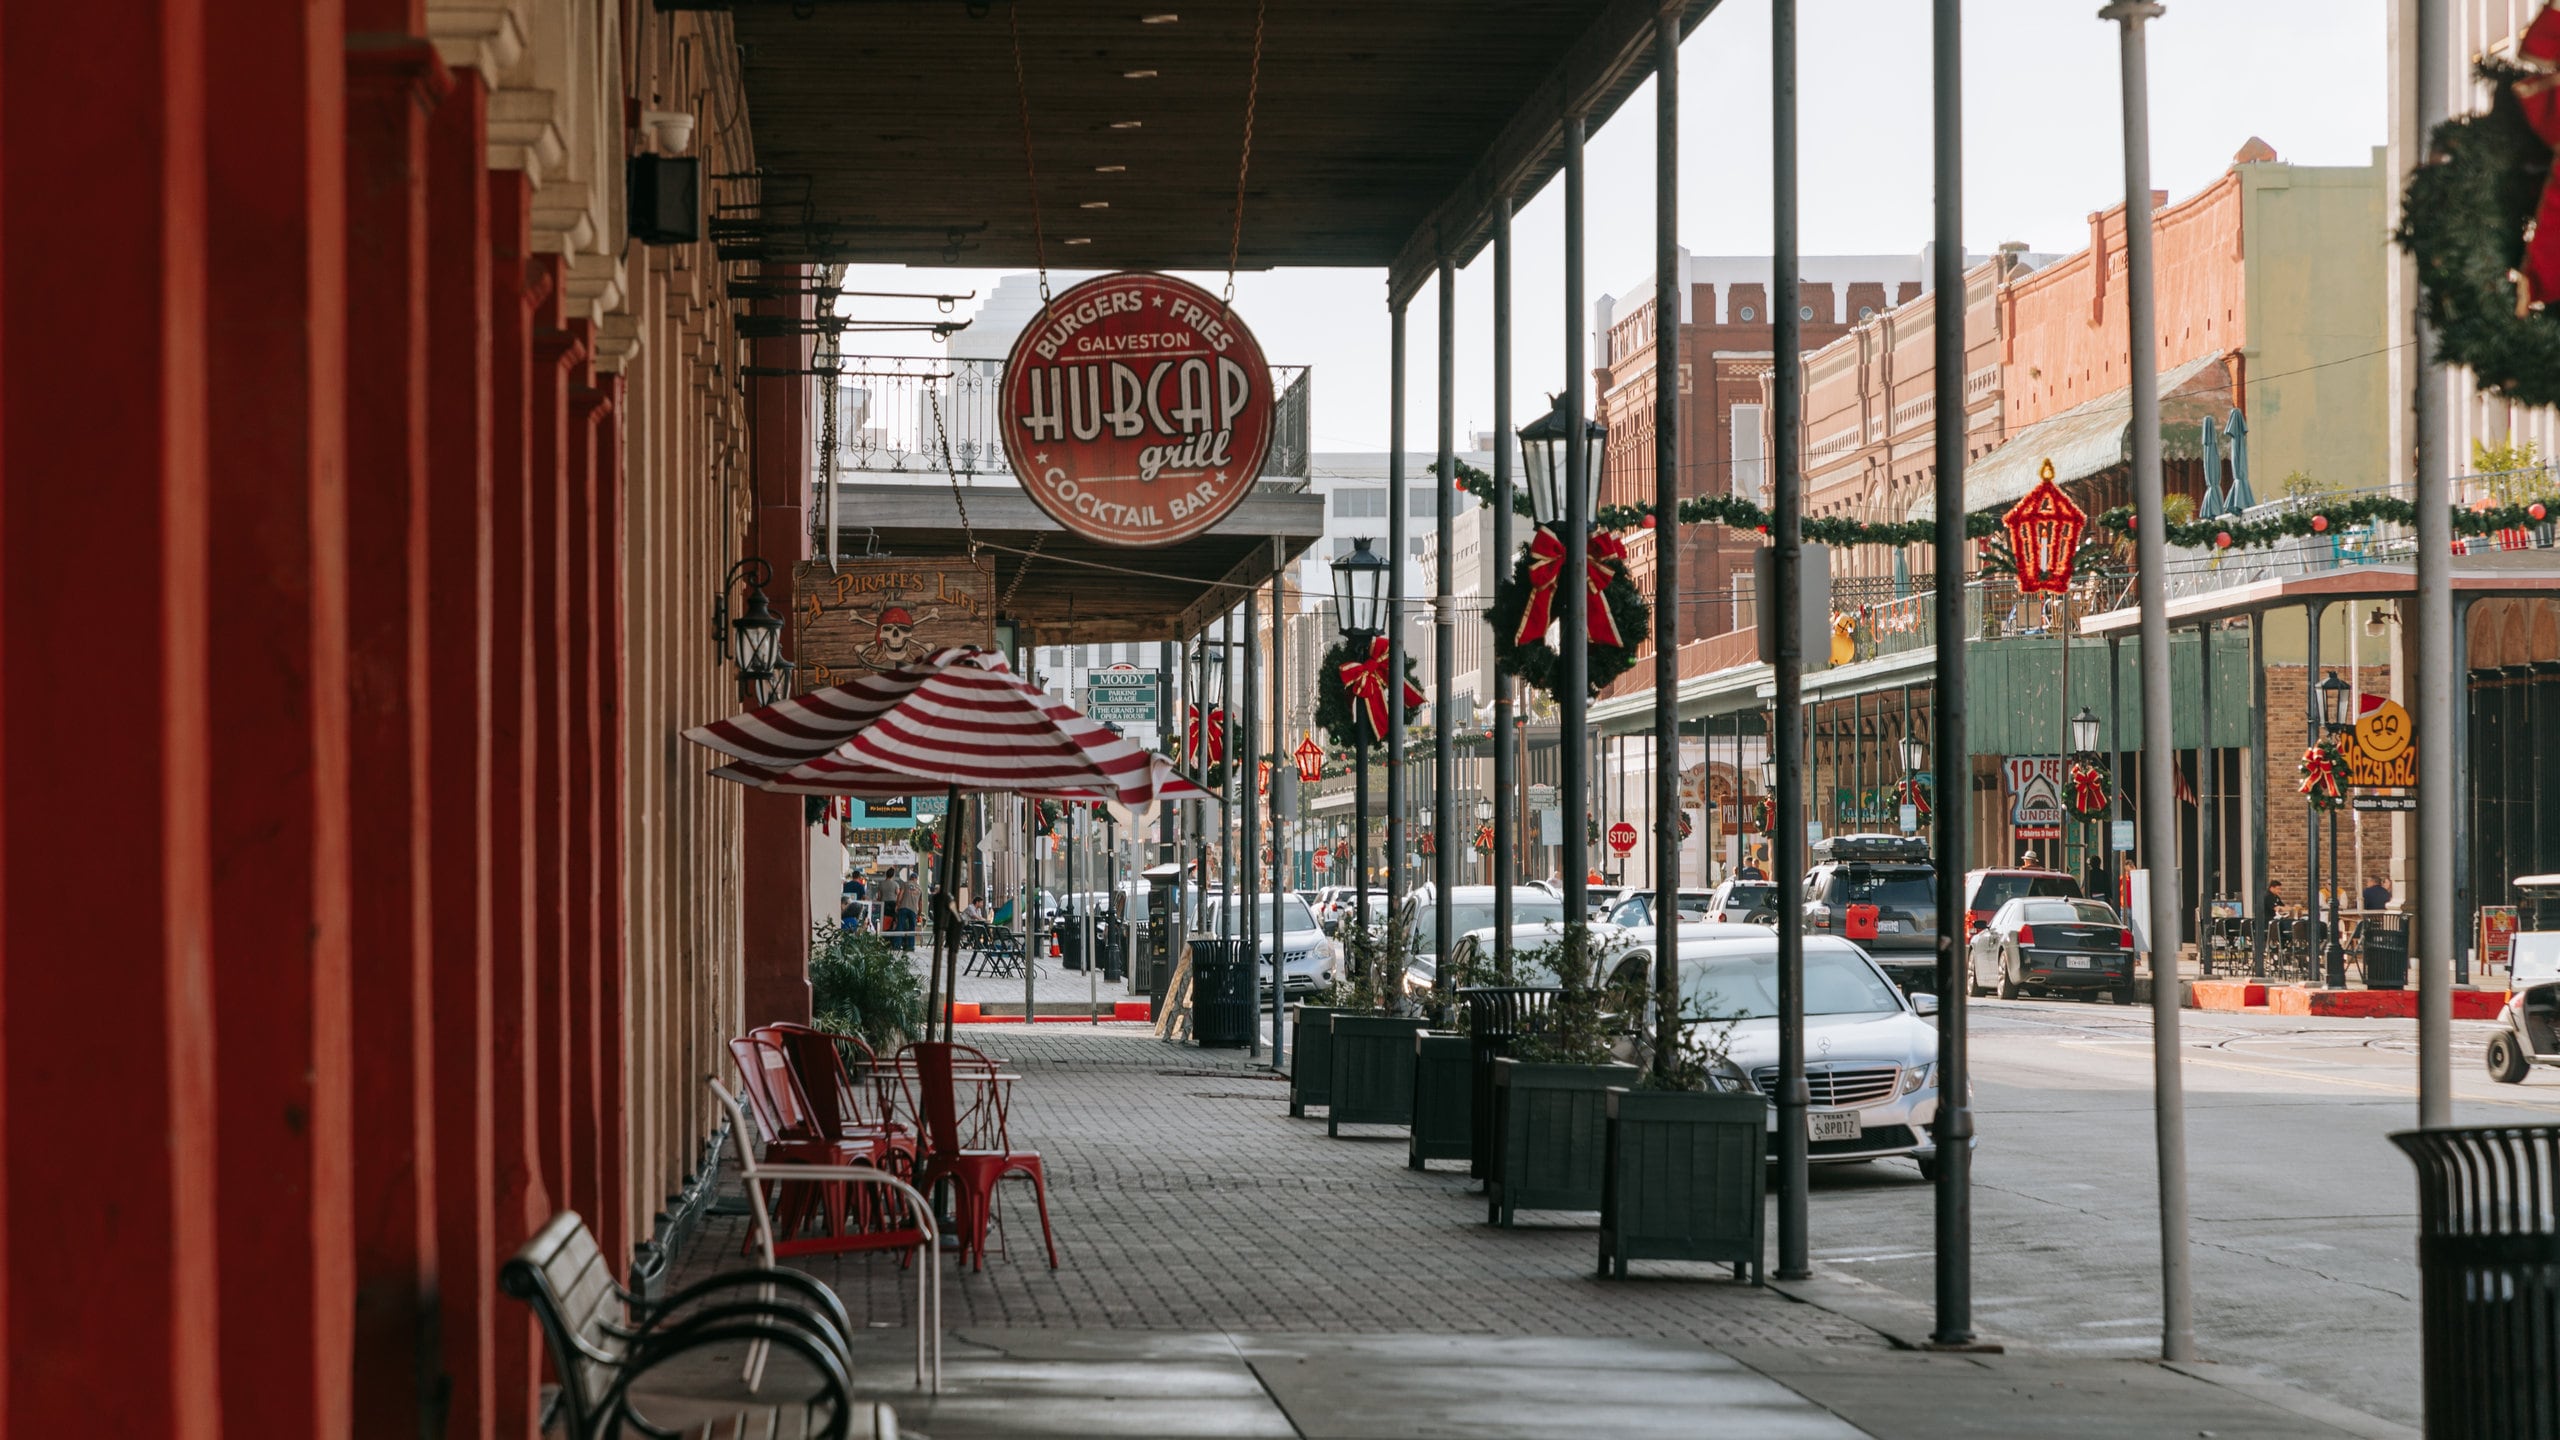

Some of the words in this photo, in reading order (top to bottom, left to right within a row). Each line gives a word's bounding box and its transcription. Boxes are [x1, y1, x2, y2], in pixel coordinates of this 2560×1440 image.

[1035, 290, 1143, 361] BURGERS
[1169, 298, 1234, 352] FRIES
[1077, 332, 1190, 352] GALVESTON
[1021, 356, 1249, 441] HUBCAP
[1139, 430, 1232, 482] grill
[1044, 467, 1163, 527] COCKTAIL
[1169, 480, 1218, 521] BAR
[1100, 675, 1146, 685] MOODY
[2010, 760, 2034, 791] 10
[2385, 736, 2419, 787] DAZ
[1722, 804, 1753, 824] PELAN
[2019, 811, 2060, 821] UNDER
[1610, 831, 1636, 843] STOP
